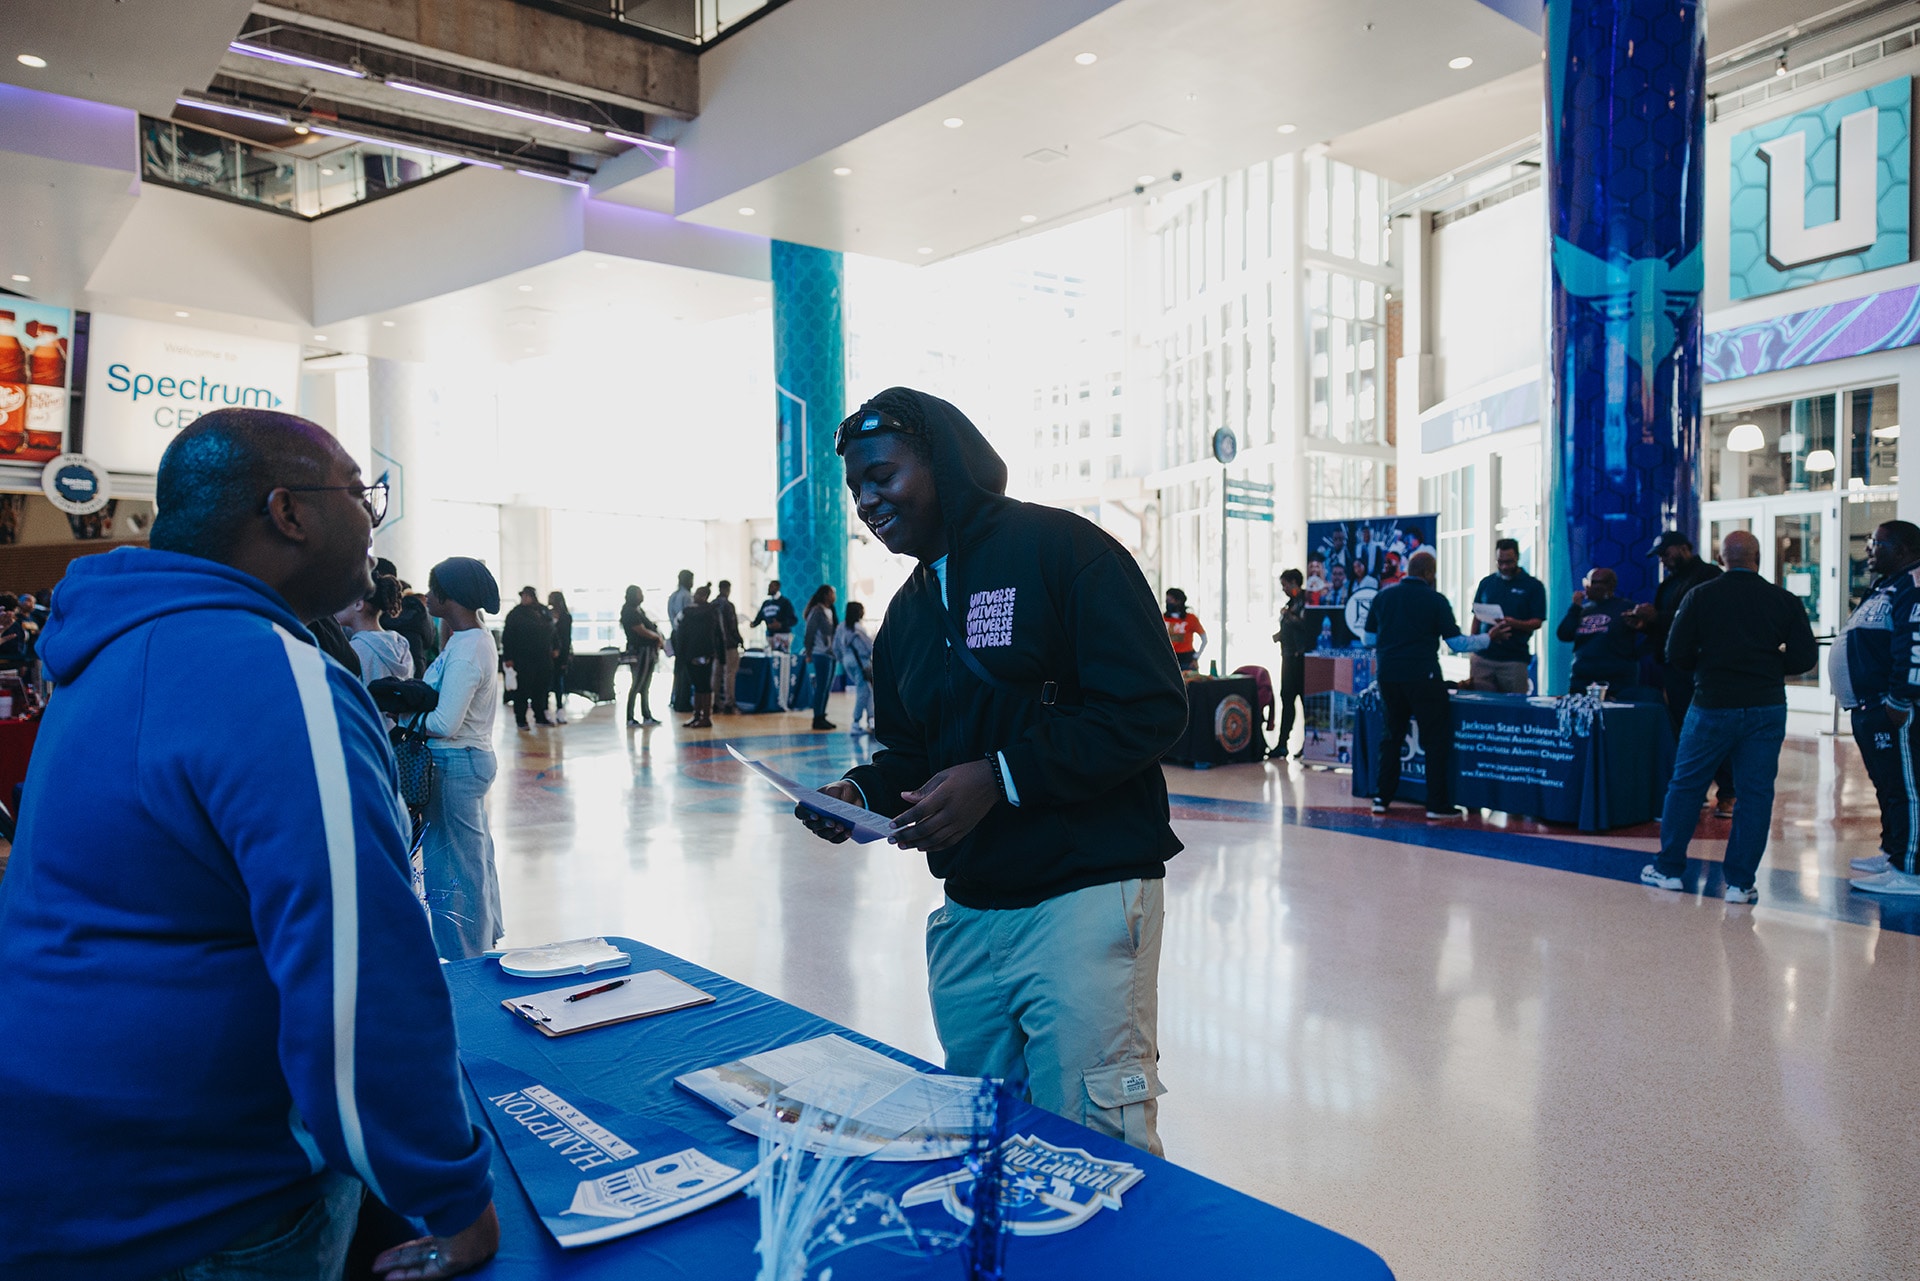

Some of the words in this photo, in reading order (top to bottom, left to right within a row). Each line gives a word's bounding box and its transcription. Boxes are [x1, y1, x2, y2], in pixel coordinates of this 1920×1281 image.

[1757, 106, 1879, 272] U
[107, 363, 273, 409] Spectrum
[154, 406, 203, 429] CE
[969, 587, 1016, 608] UNIVERSE
[966, 602, 1014, 622] UNIVERSE
[966, 616, 1013, 636] UNIVERSE
[965, 631, 1012, 649] UNIVERSE
[1454, 731, 1485, 740] National
[1461, 720, 1495, 732] Jackson
[1496, 722, 1521, 734] State
[1523, 724, 1562, 737] Universi
[1476, 743, 1510, 755] Charlotte
[1540, 749, 1575, 761] Chapter
[488, 1091, 614, 1172] HAMPTON
[528, 1086, 632, 1157] UNIVERSITY
[1001, 1145, 1119, 1191] HAMPTON
